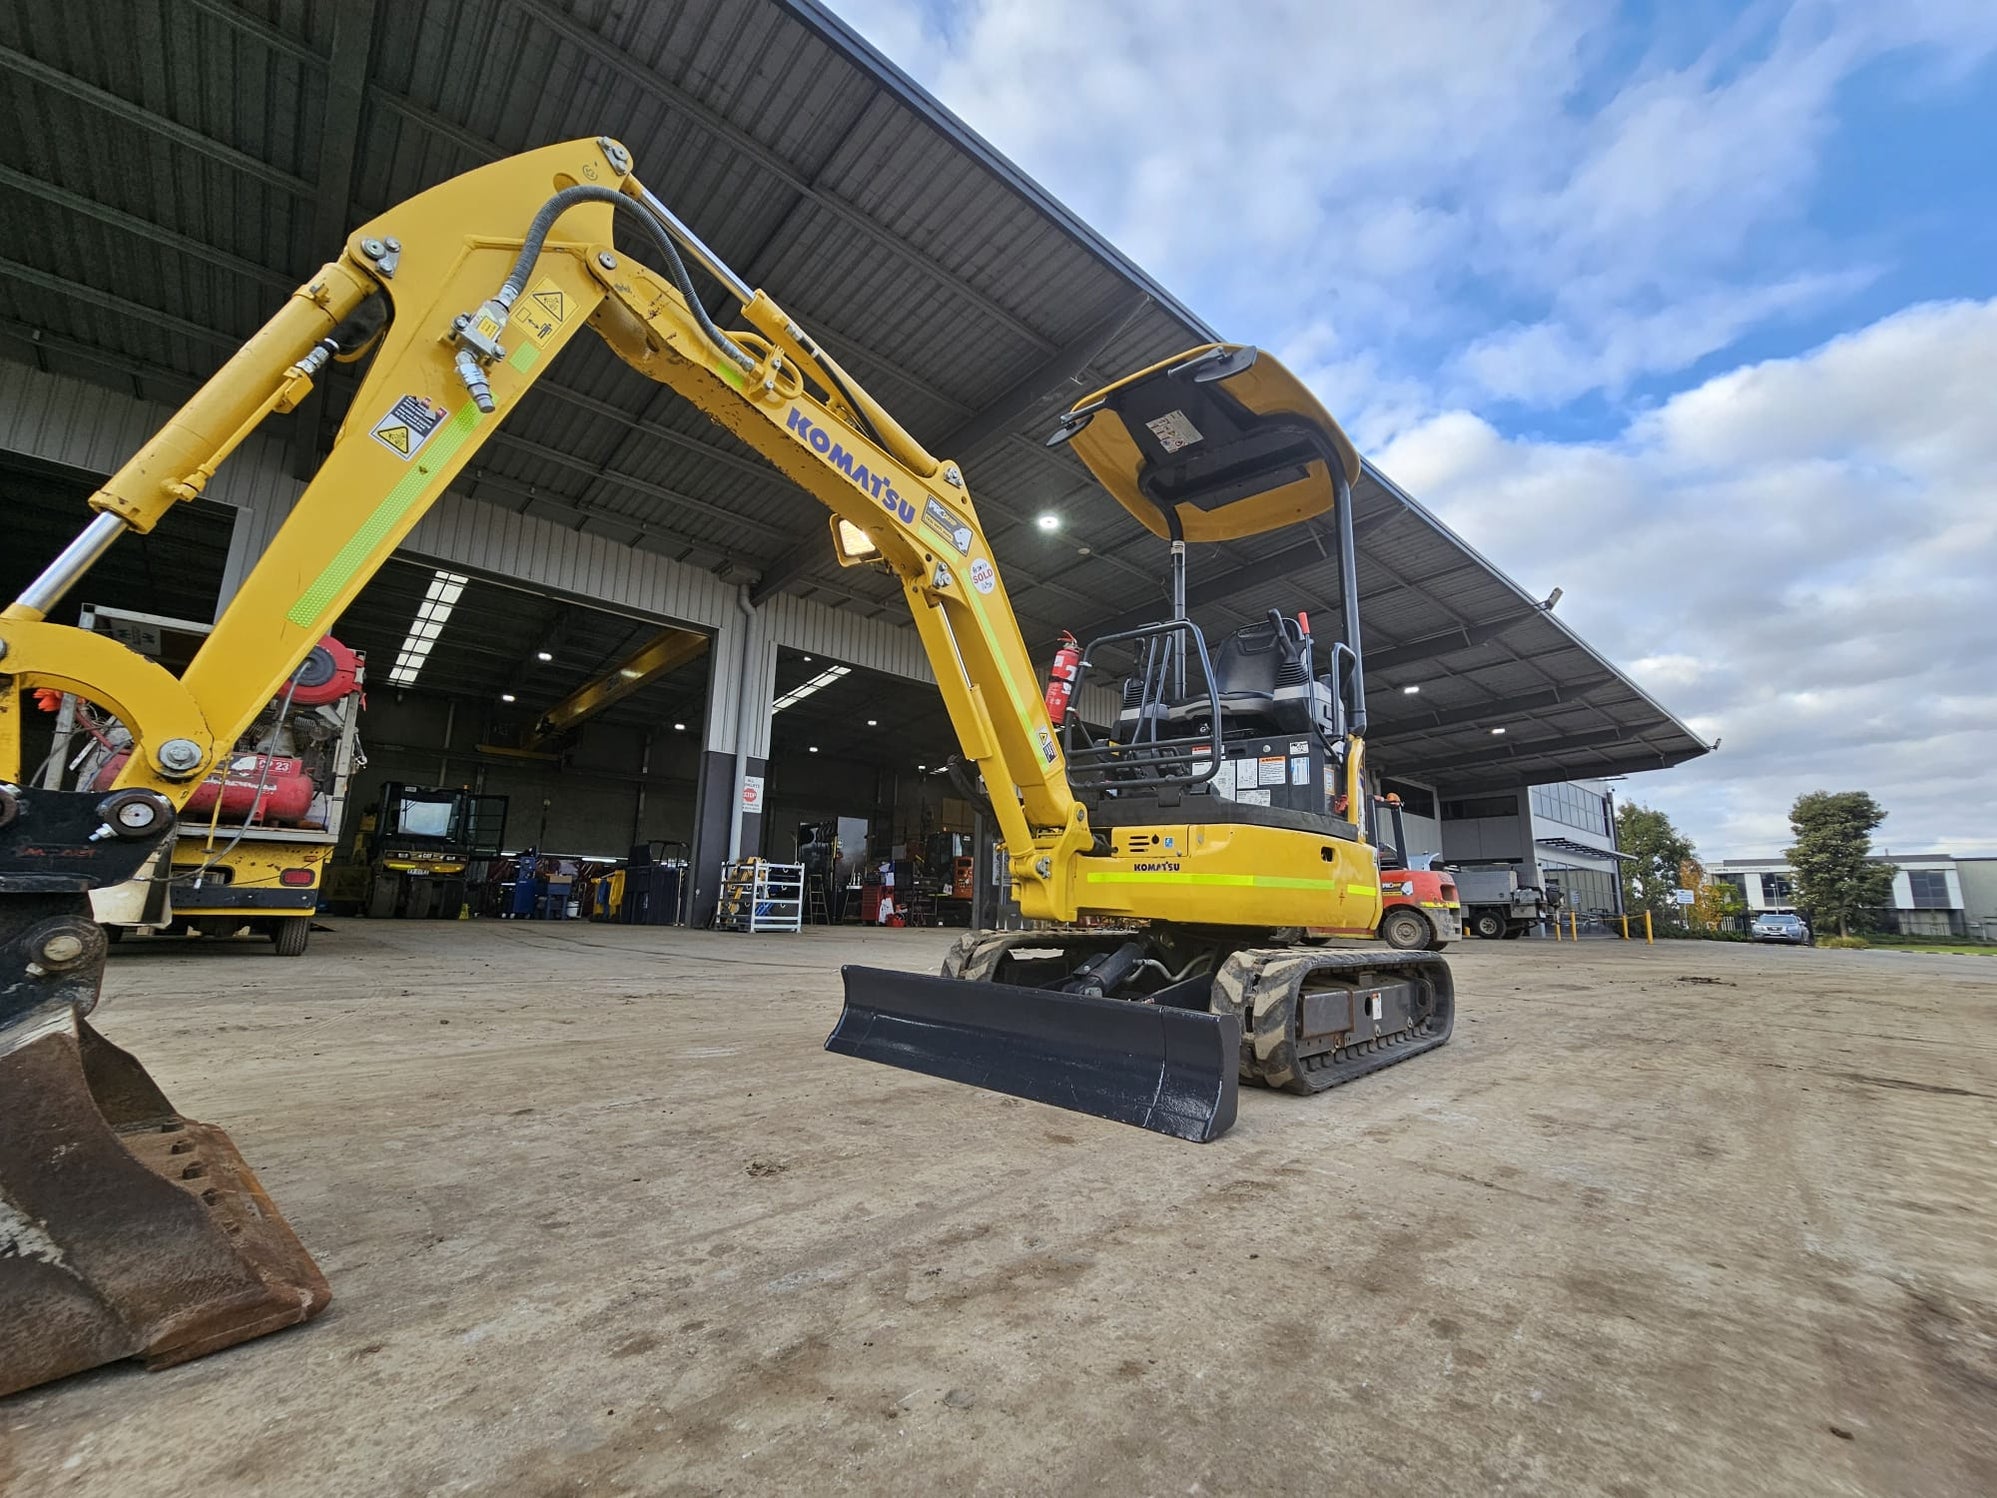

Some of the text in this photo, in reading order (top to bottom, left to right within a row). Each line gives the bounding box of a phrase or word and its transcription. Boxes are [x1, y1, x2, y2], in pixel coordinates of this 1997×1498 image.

[786, 406, 916, 524] KOMATSU
[972, 568, 993, 584] SOLD
[275, 762, 289, 771] 23
[1134, 862, 1180, 871] KOMATSU
